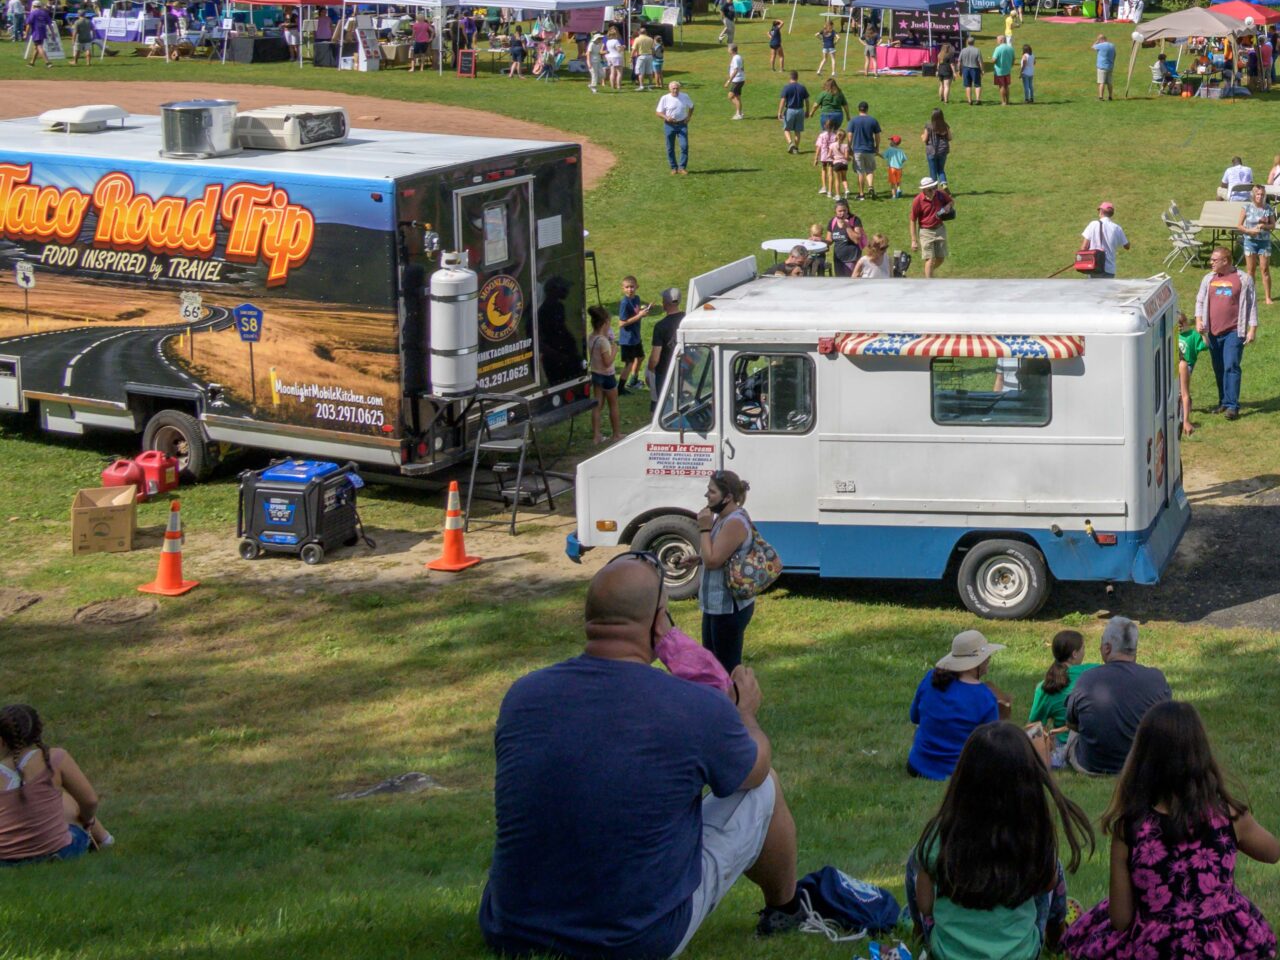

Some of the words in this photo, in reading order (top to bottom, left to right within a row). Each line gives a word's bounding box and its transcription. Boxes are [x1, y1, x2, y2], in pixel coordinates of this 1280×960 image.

[971, 0, 995, 7] Union
[911, 21, 924, 29] Just
[930, 22, 950, 30] Dance
[0, 162, 91, 243] Taco
[93, 171, 223, 258] Road
[221, 181, 315, 288] Trip
[41, 245, 78, 266] FOOD
[81, 249, 147, 273] INSPIRED
[150, 256, 163, 280] by
[168, 258, 223, 281] TRAVEL
[184, 305, 199, 318] 66
[241, 317, 258, 332] S8
[275, 379, 384, 406] MoonlightMobileKitchen.com
[315, 403, 384, 426] 203.297.0625
